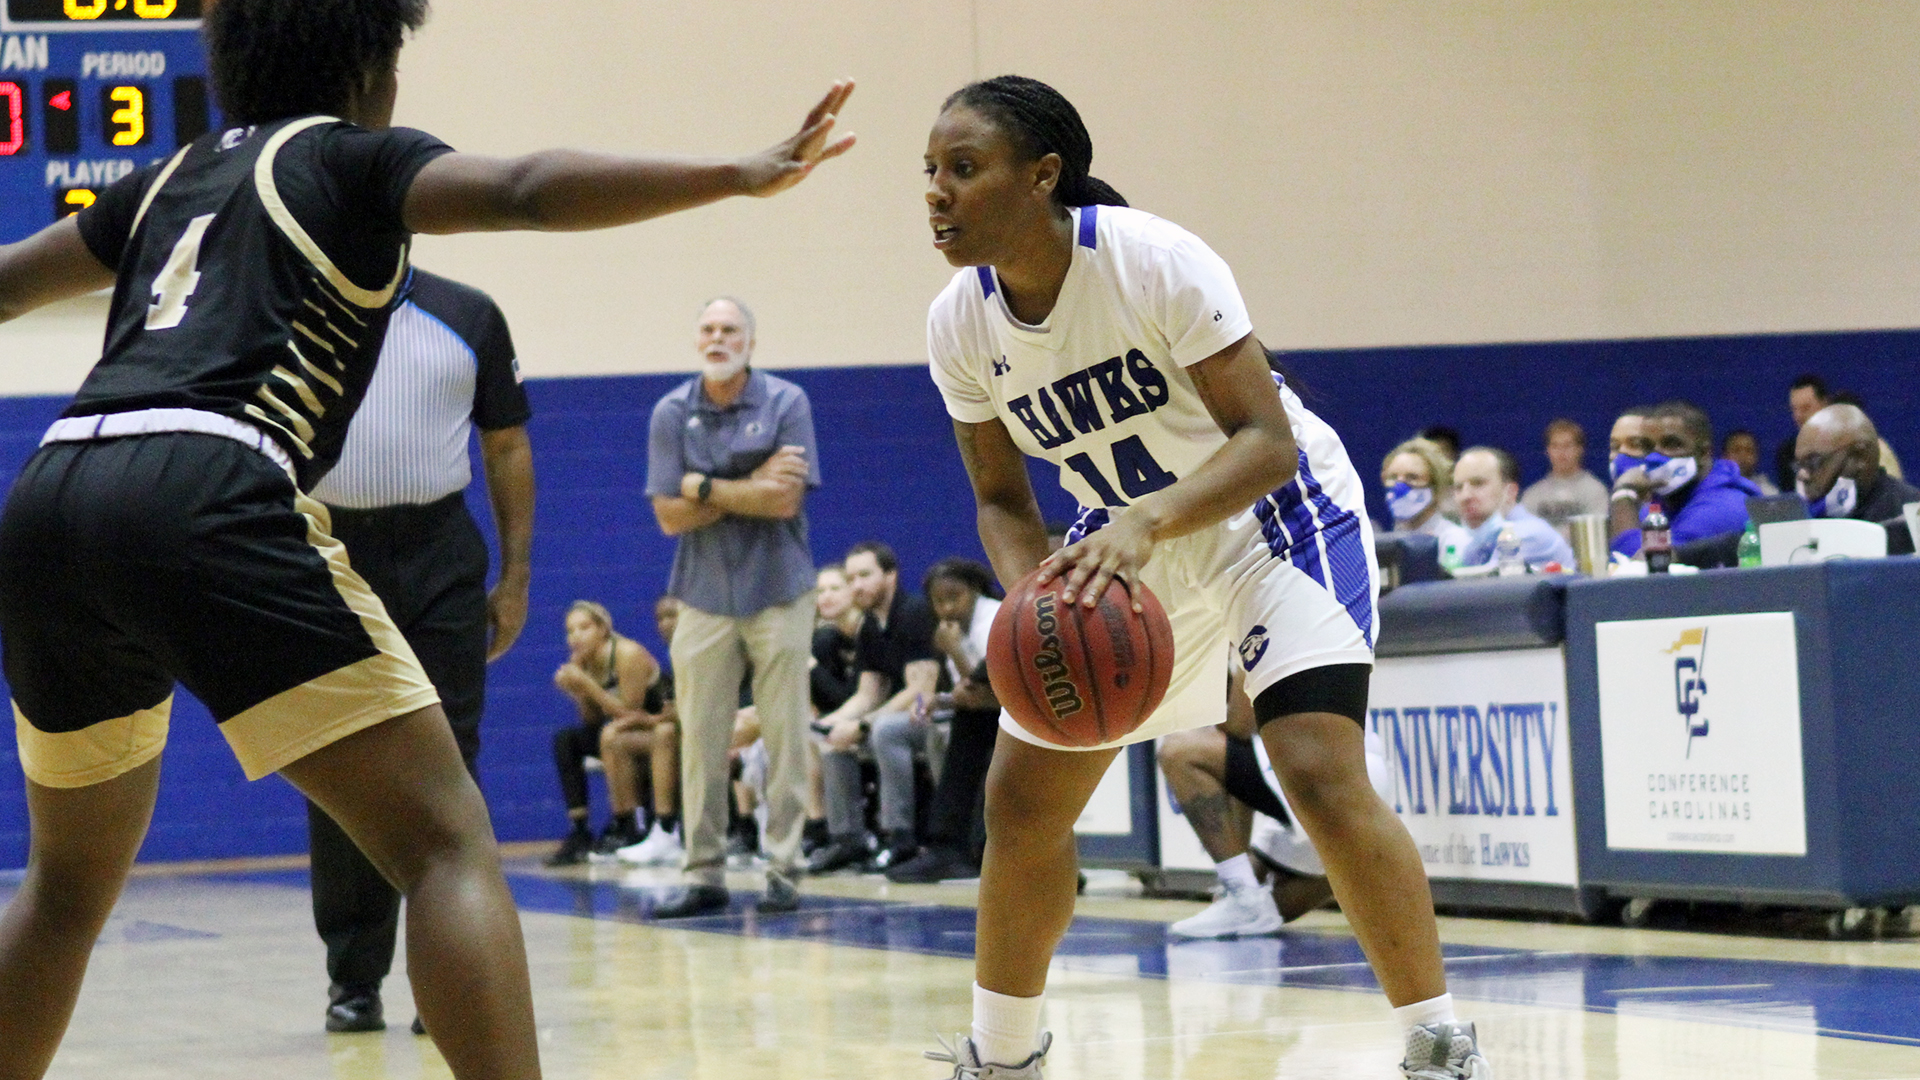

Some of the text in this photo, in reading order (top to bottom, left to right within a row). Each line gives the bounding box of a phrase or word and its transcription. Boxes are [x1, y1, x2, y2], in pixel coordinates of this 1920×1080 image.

[0, 35, 48, 71] AN
[82, 51, 166, 78] PERIOD
[110, 86, 144, 146] 3
[144, 212, 217, 330] 4
[1007, 348, 1169, 450] HAWKS
[1064, 434, 1178, 507] 14
[1033, 591, 1085, 720] Wilson
[1648, 773, 1750, 793] CONFERENCE
[1649, 800, 1751, 820] CAROLINAS
